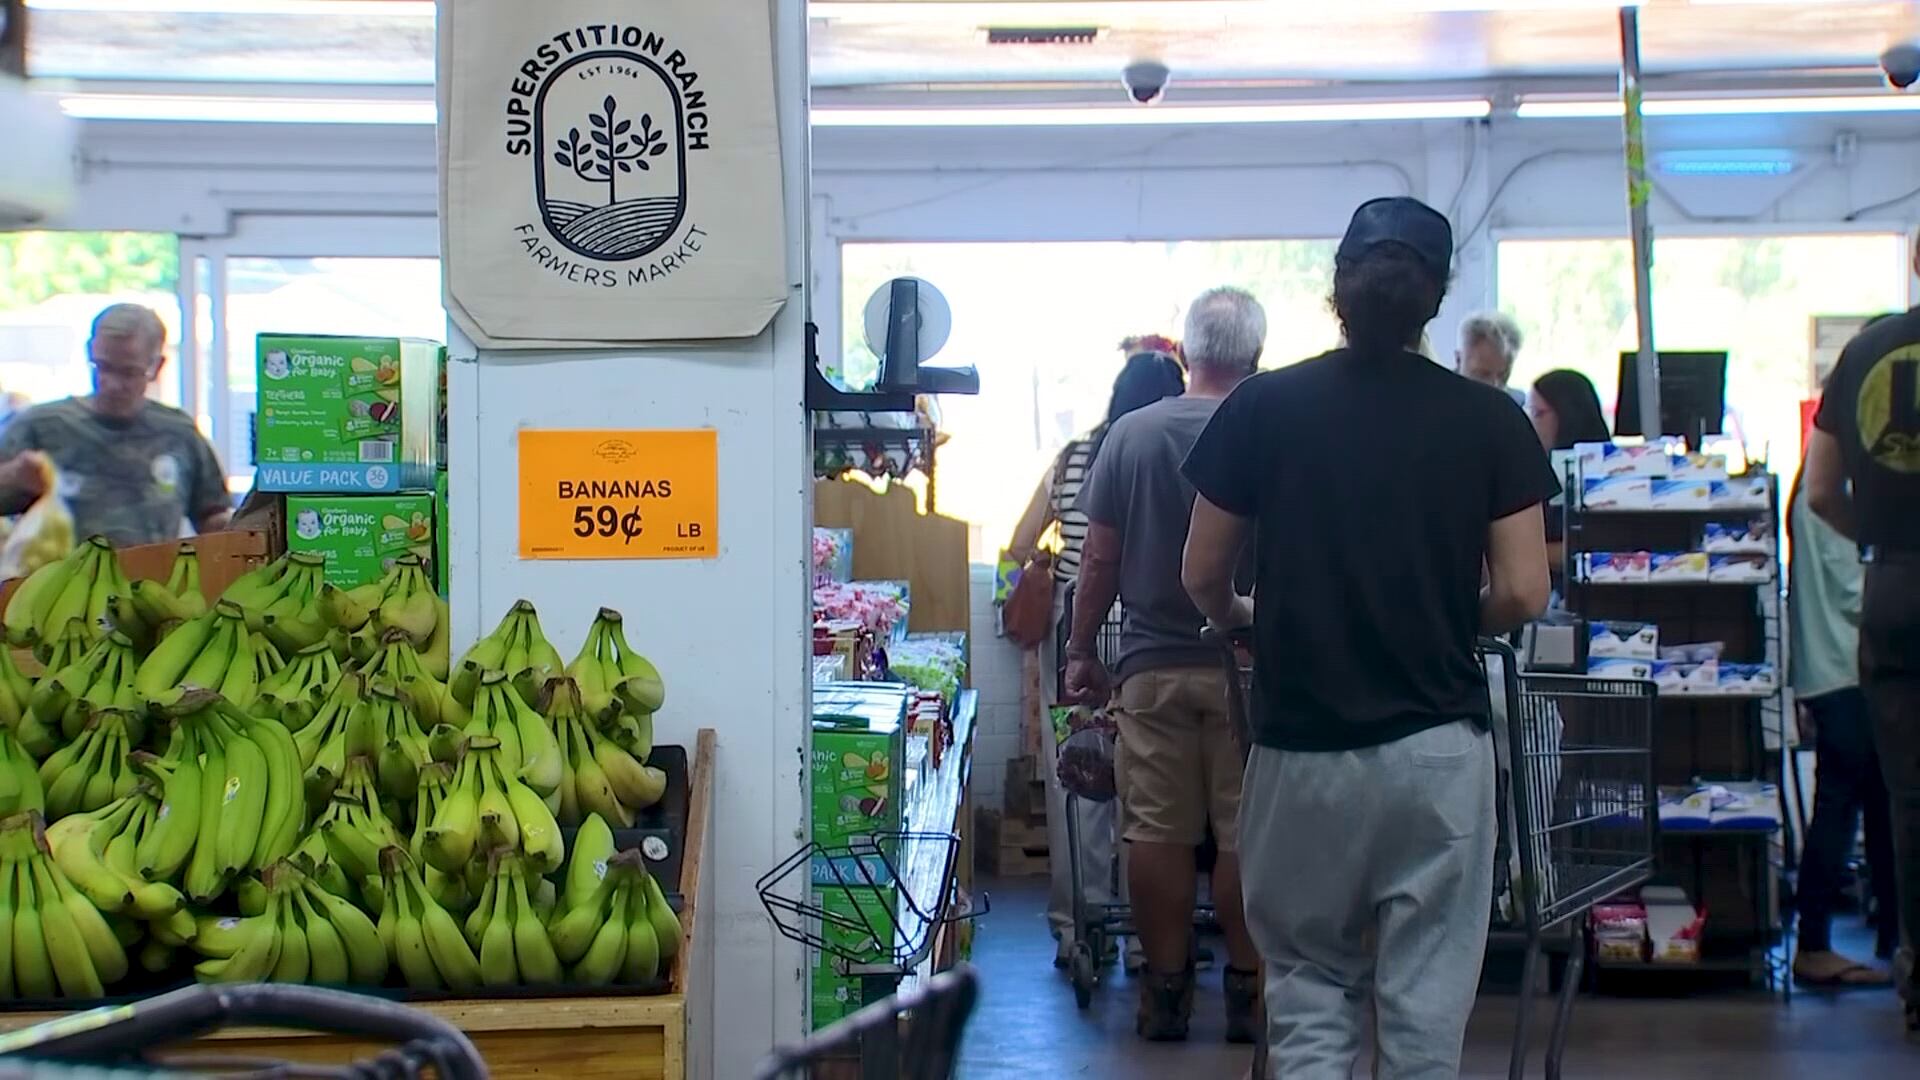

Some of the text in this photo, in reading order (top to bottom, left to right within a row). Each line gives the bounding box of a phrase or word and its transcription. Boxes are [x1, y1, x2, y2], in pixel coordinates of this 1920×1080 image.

[578, 65, 601, 80] EST
[506, 24, 709, 156] SUPERSTITION RANCH
[514, 223, 708, 287] FARMERS MARKET
[292, 354, 344, 368] Organic
[292, 367, 308, 377] for
[262, 469, 314, 485] VALUE
[320, 470, 362, 486] PACK
[558, 480, 672, 499] BANANAS
[322, 513, 376, 526] Organic
[573, 505, 702, 545] 59¢ LB
[323, 526, 338, 536] for
